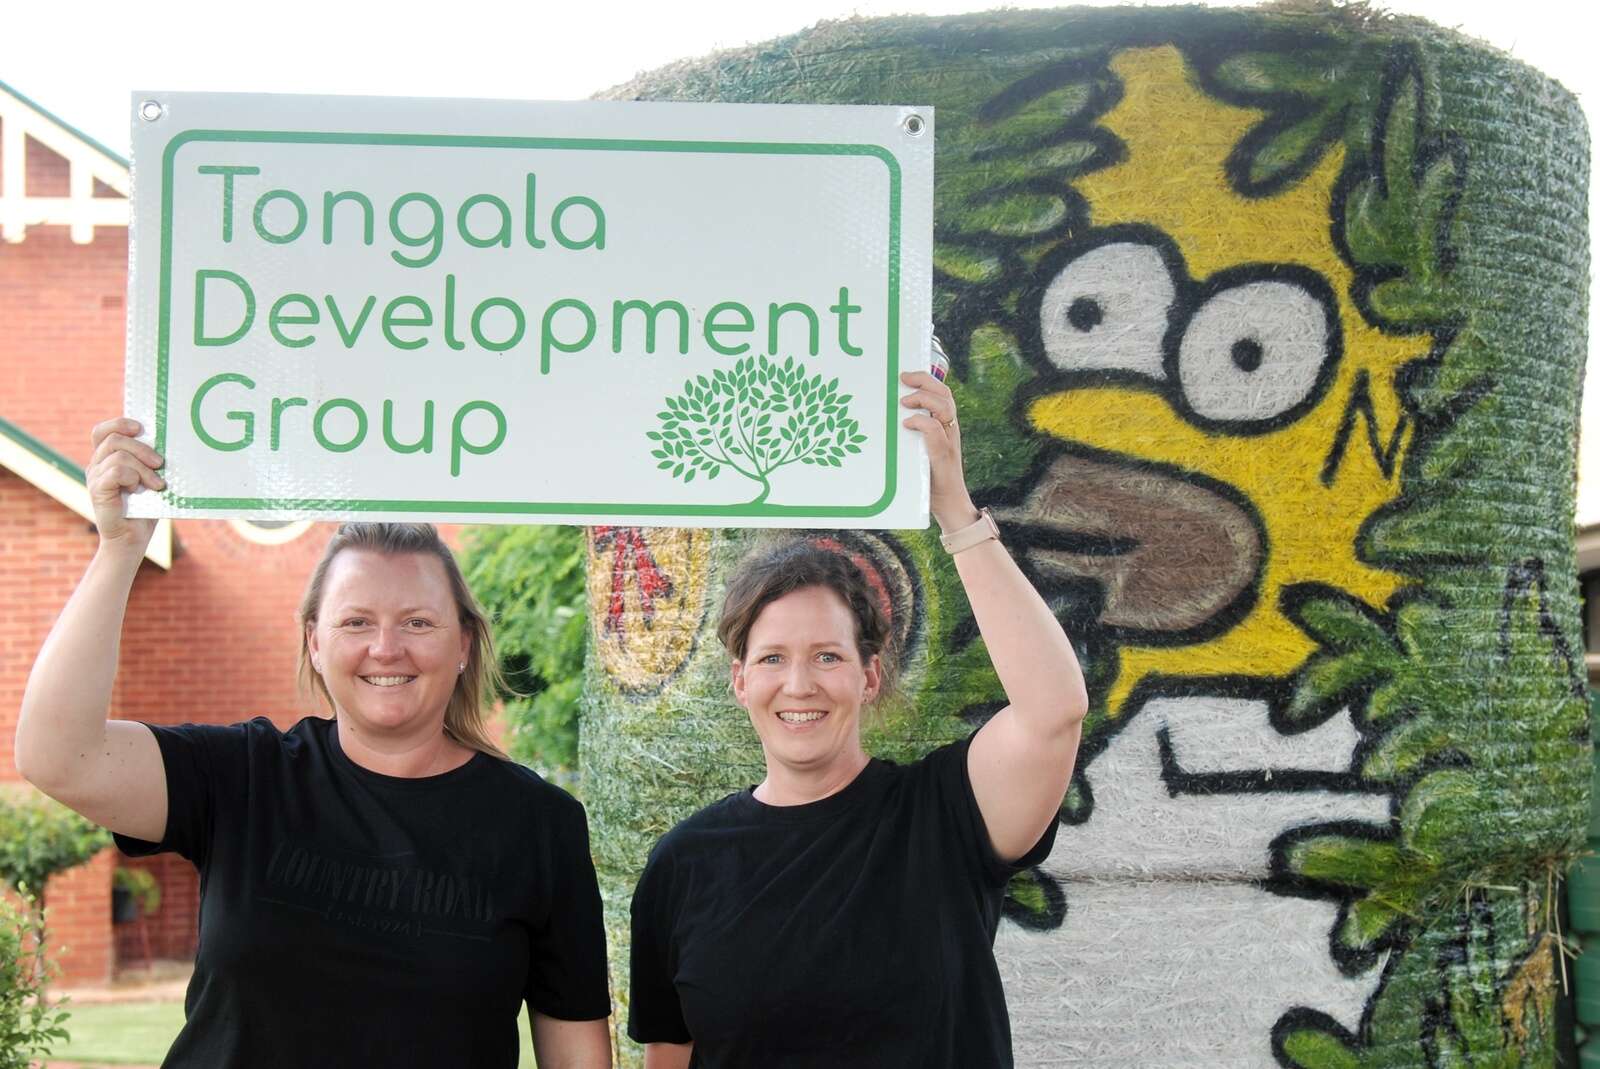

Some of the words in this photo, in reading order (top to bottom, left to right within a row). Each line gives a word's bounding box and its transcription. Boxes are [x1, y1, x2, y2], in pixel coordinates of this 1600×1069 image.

[198, 164, 607, 269] Tongala
[194, 268, 865, 376] Development
[190, 371, 508, 478] Group
[265, 840, 410, 912] COUNTRY
[411, 868, 497, 923] ROAD
